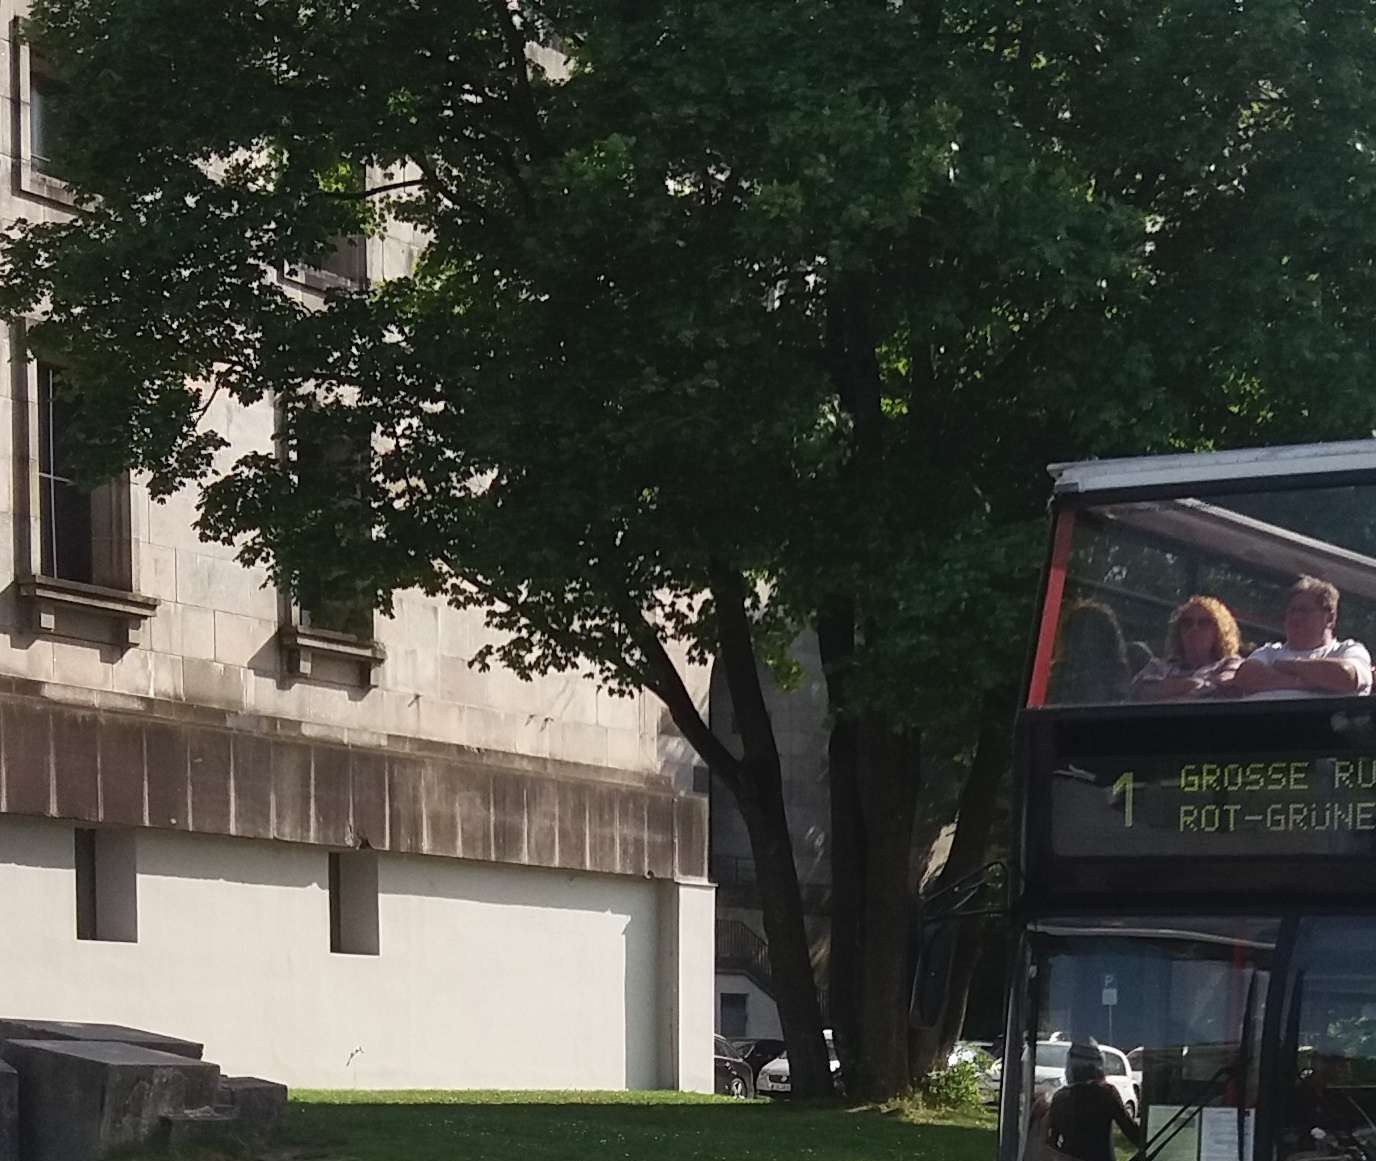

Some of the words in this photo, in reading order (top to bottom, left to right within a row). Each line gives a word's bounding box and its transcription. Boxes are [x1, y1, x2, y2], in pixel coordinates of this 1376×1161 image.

[1180, 761, 1309, 792] GROSSE
[1112, 771, 1134, 828] 1
[1180, 802, 1376, 831] ROT-GRÜNE
